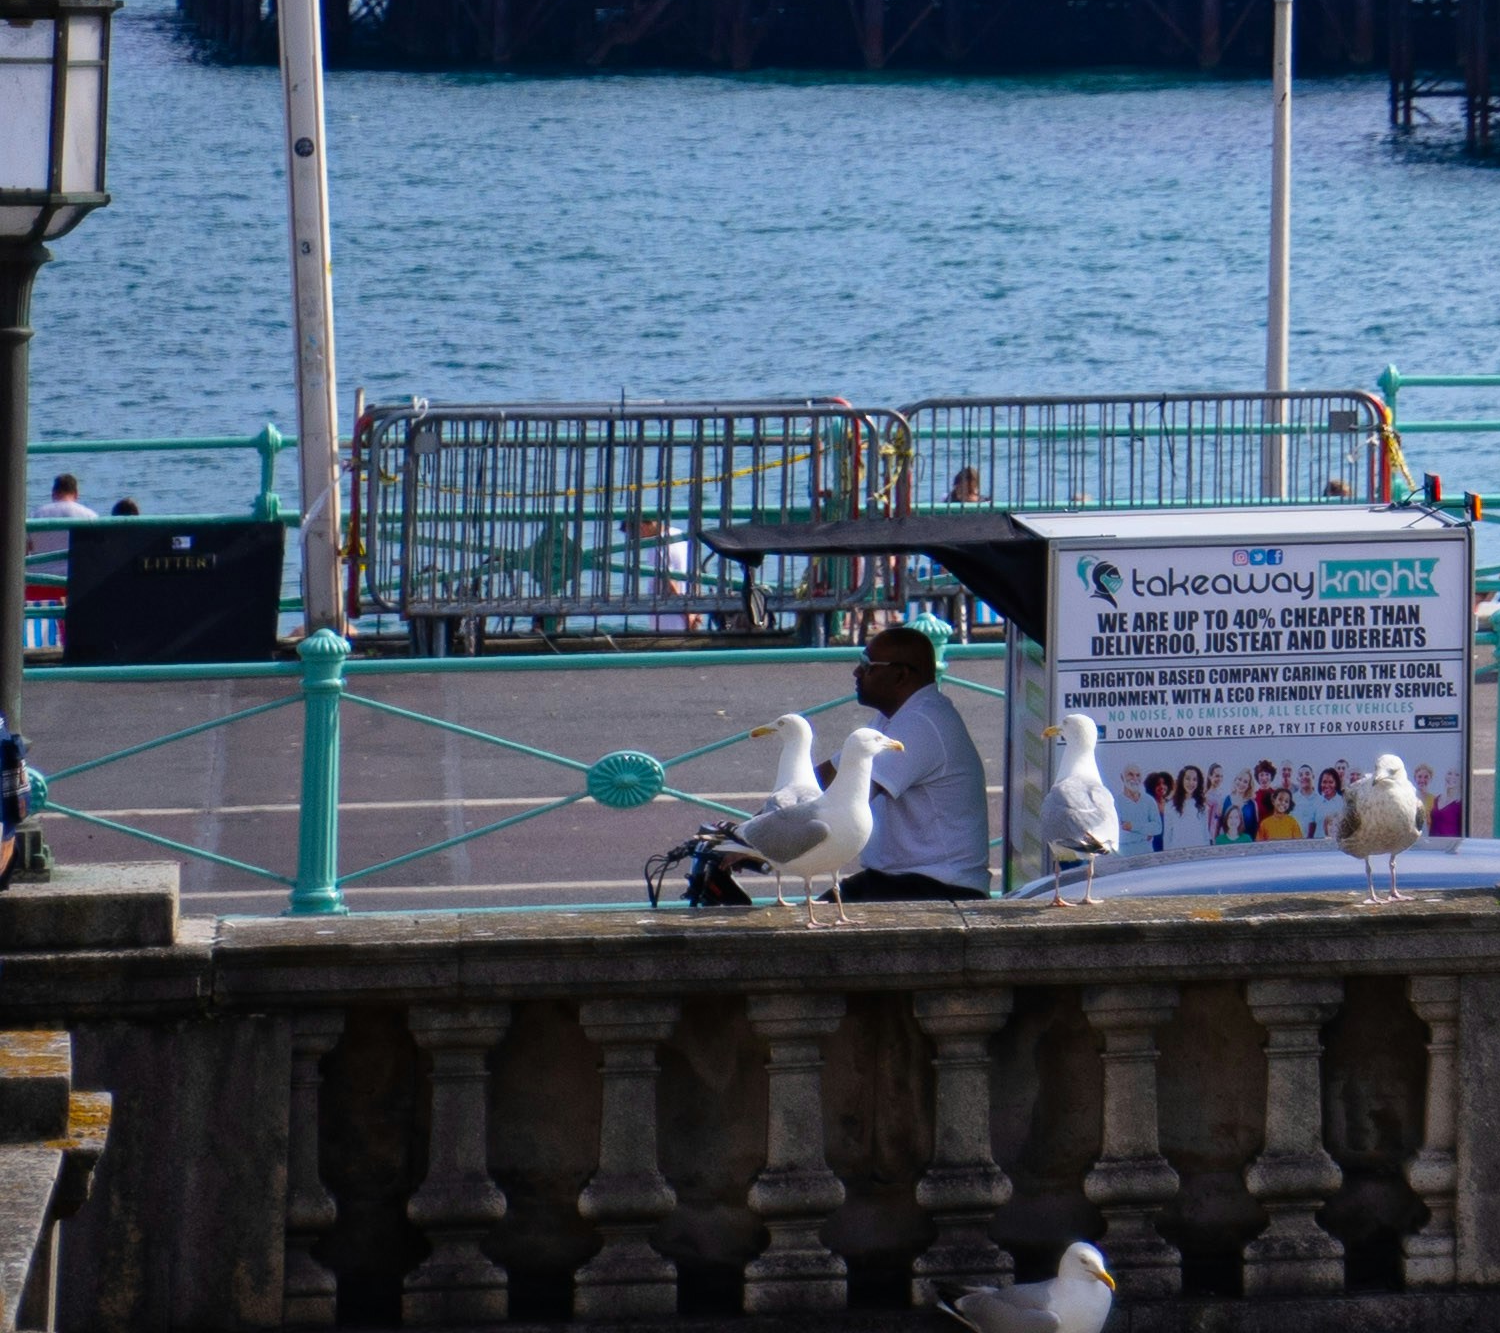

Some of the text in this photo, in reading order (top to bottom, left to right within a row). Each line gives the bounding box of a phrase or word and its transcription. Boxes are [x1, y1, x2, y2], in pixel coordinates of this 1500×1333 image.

[301, 241, 311, 255] 3
[143, 556, 207, 570] LITTER
[1132, 560, 1429, 600] takeaway knight
[1098, 604, 1420, 633] WE ARE UP TO 40% CHEAPER THAN
[1091, 626, 1426, 656] DELIVEROO, JUSTEAT AND UBEREATS
[1080, 662, 1443, 688] BRIGHTON BASED COMPANY CARING FOR THE LOCAL
[1065, 681, 1457, 709] ENVIRONMENT, WITH A ECO FRIENDLY DELIVERY SERVICE.
[1108, 701, 1414, 722] NO NOISE, NO EMISSION, ALL ELECTRIC VEHICLES
[1117, 719, 1405, 740] DOWNLOAD OUR FREE APP, TRY IT FOR YOURSELF
